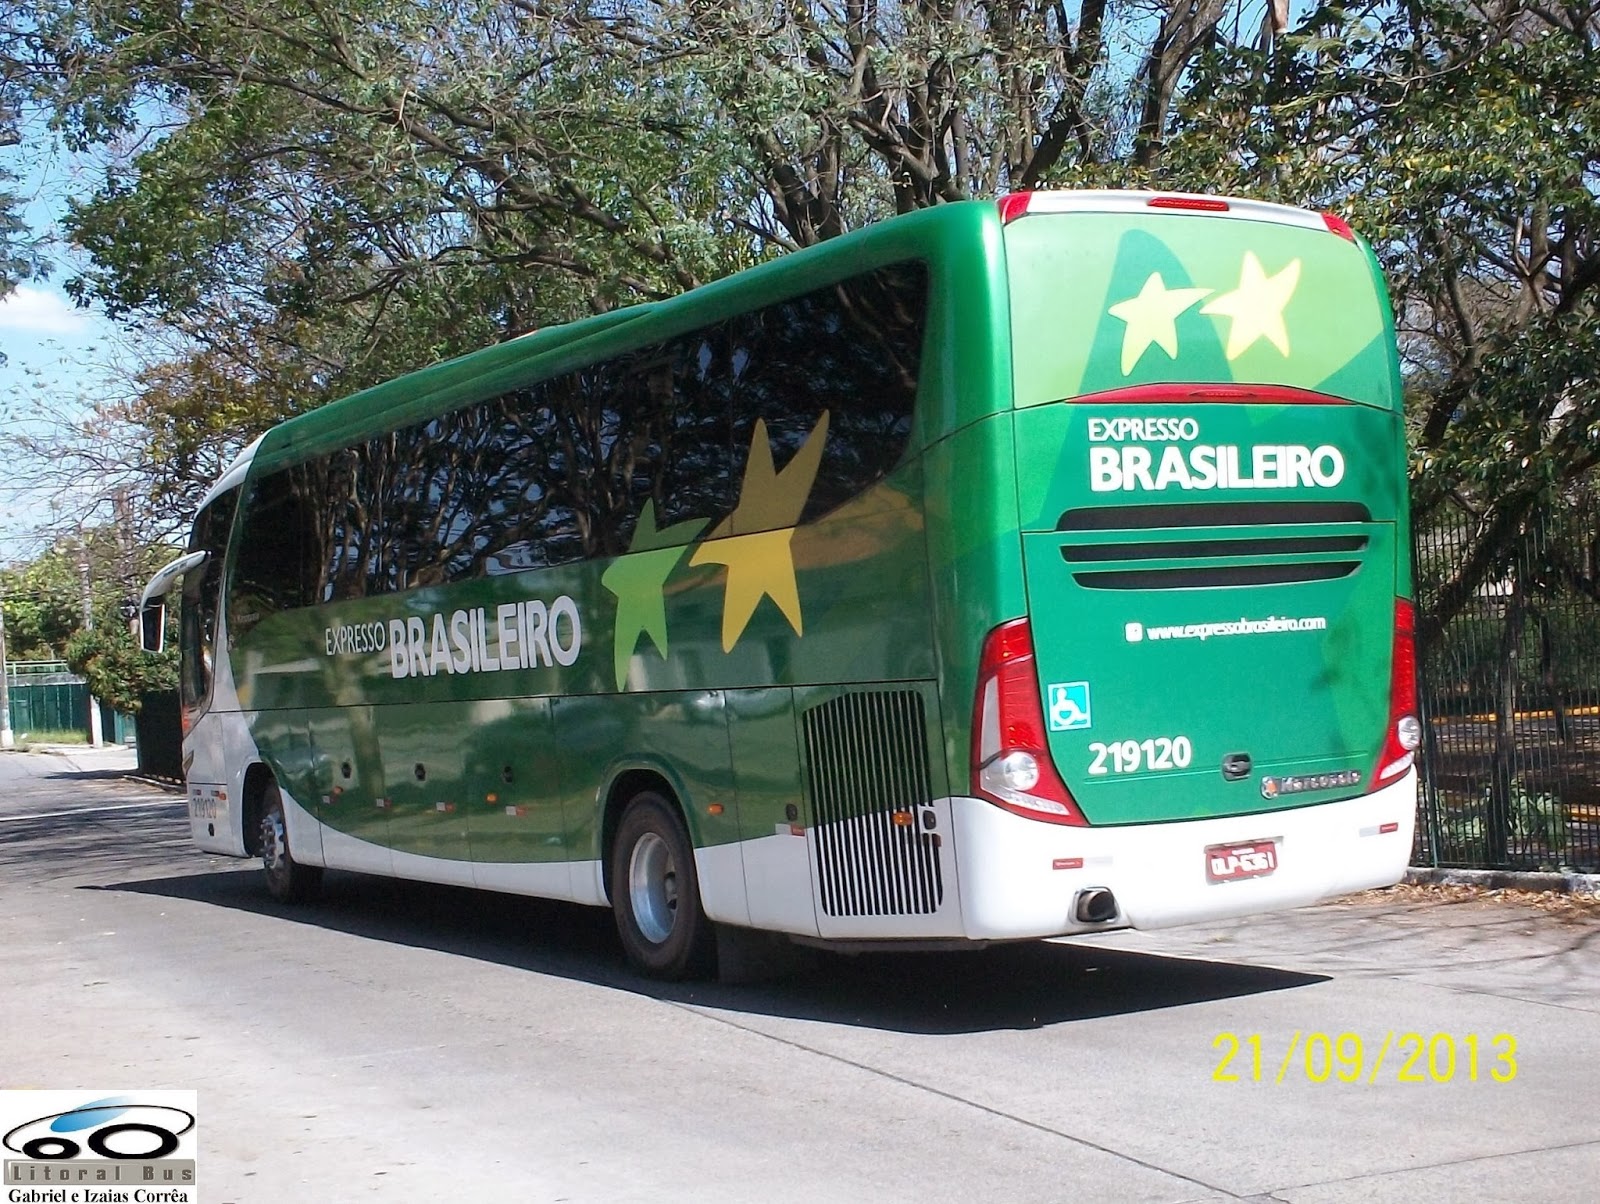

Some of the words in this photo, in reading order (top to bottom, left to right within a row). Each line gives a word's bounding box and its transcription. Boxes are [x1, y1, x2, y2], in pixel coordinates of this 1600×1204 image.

[1088, 418, 1199, 441] EXPRESSO
[1090, 445, 1345, 492] BRASILEIRO
[325, 621, 386, 656] EXPRESSO
[389, 595, 581, 679] BRASILEIRO
[1147, 616, 1326, 641] www.expressobrasileiro.com
[1087, 735, 1192, 775] 219120
